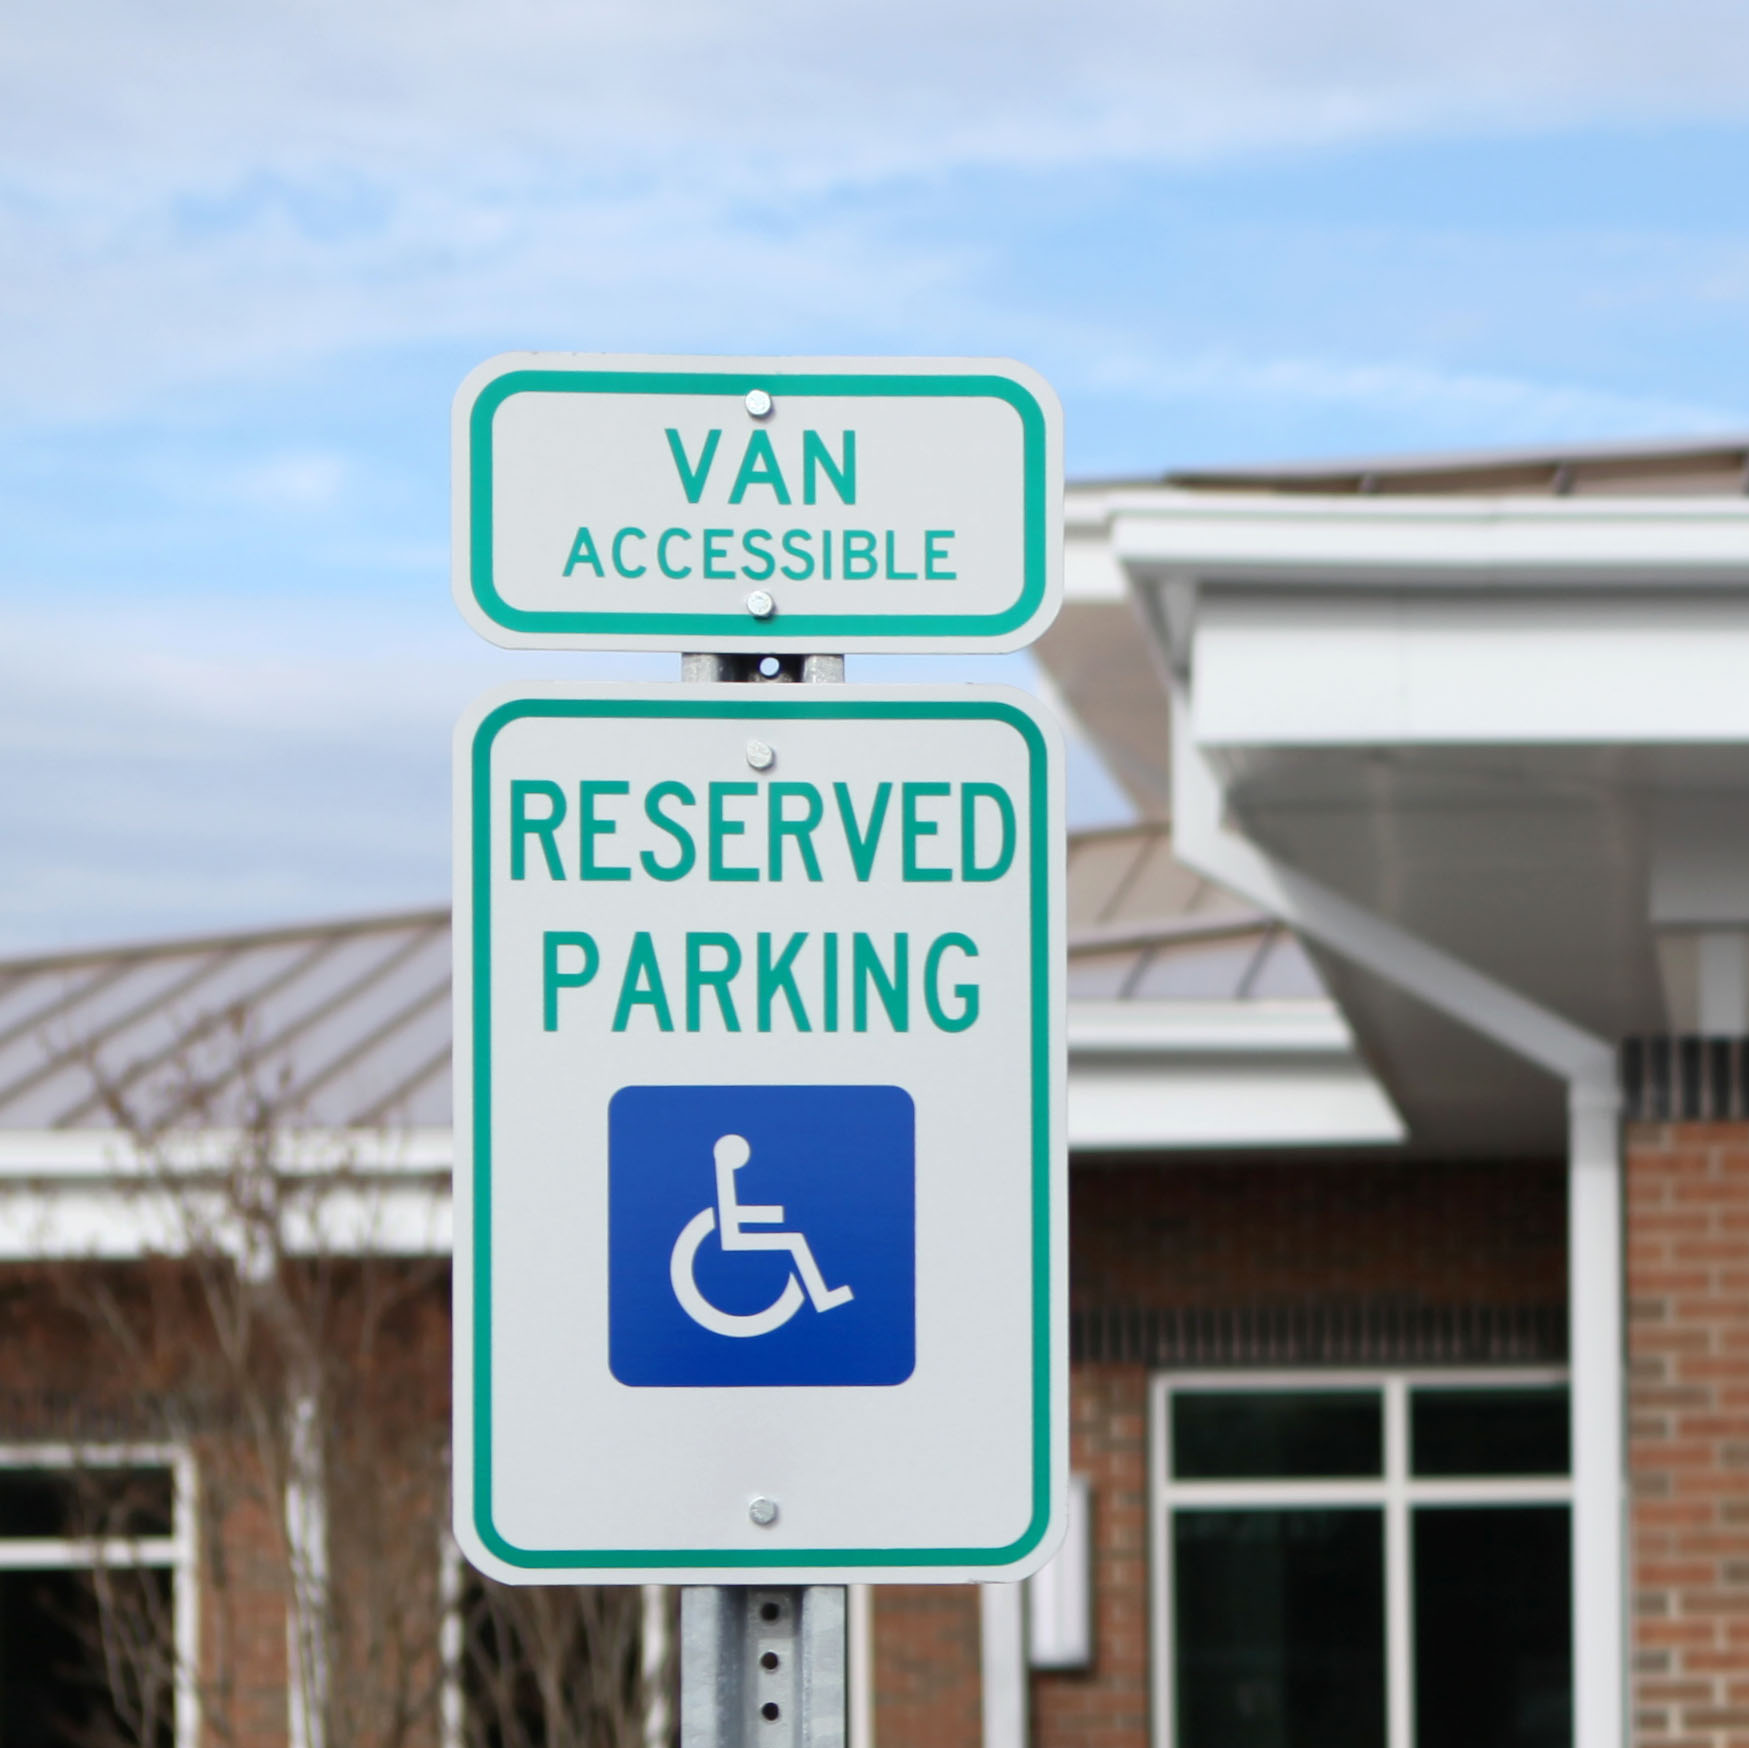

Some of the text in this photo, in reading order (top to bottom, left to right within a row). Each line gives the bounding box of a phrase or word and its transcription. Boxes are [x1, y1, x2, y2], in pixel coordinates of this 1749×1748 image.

[665, 428, 857, 505] VAN
[563, 526, 957, 581] ACCESSIBLE
[511, 779, 1017, 882] RESERVED
[543, 930, 980, 1033] PARKING
